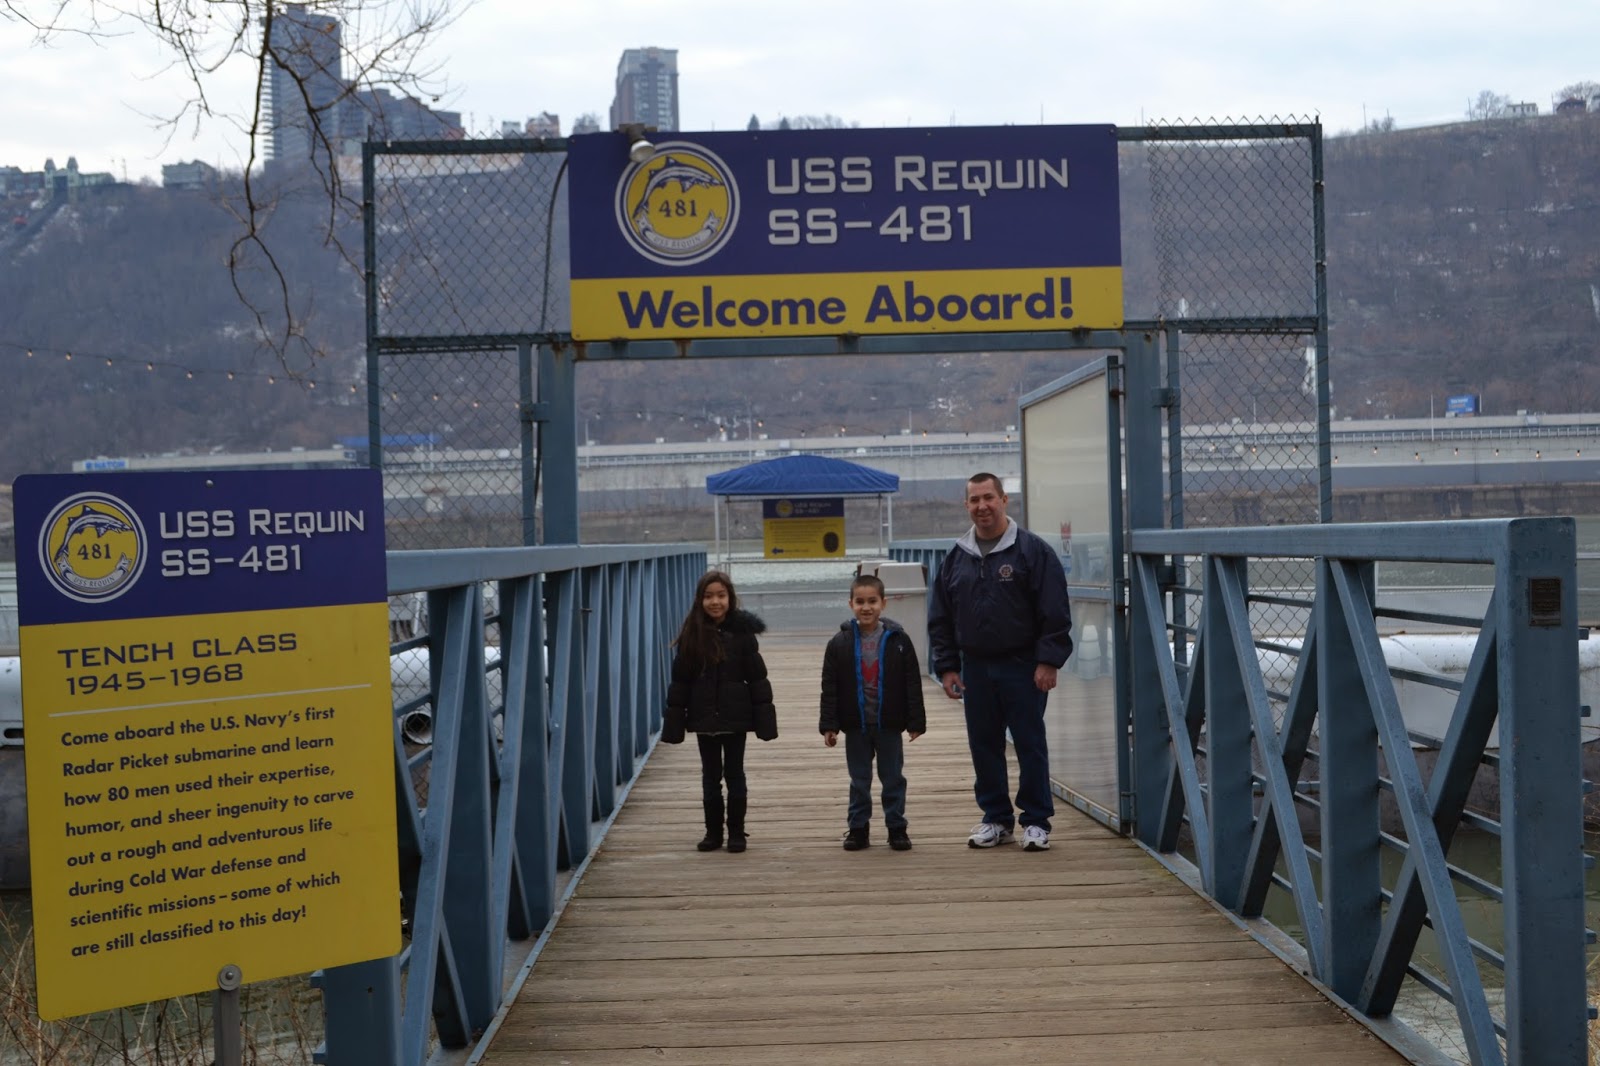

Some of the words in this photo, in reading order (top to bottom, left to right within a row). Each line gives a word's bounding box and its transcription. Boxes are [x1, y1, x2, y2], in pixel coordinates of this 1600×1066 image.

[767, 157, 872, 194] USS
[895, 156, 1068, 196] REQUIN
[659, 199, 697, 218] 481
[768, 205, 971, 245] SS-481
[618, 285, 846, 329] Welcome
[865, 277, 1073, 323] Aboard!
[159, 510, 234, 538] USS
[249, 509, 364, 538] REQUIN
[77, 543, 112, 560] 481
[161, 544, 301, 577] SS-481
[74, 577, 88, 587] USS
[89, 577, 115, 588] REQUIN
[57, 642, 174, 669] TENCH
[192, 633, 297, 658] CLASS
[66, 662, 243, 695] 1945-1968
[61, 732, 108, 746] Come
[114, 721, 174, 741] aboard
[180, 720, 205, 734] the
[211, 716, 240, 730] U.S.
[245, 710, 300, 728] Navy's
[305, 707, 334, 720] first
[63, 759, 114, 776] Radar
[120, 753, 168, 770] Picket
[175, 744, 256, 764] submarine
[262, 738, 290, 754] and
[296, 736, 333, 750] learn
[64, 792, 102, 806] how
[108, 786, 129, 801] 80
[135, 785, 169, 798] men
[176, 775, 212, 793] used
[218, 771, 254, 787] their
[259, 764, 334, 784] expertise,
[66, 821, 124, 836] humor,
[130, 810, 162, 828] and
[168, 808, 211, 823] sheer
[217, 796, 288, 818] ingenuity
[294, 795, 308, 806] to
[314, 791, 354, 804] carve
[67, 852, 95, 866] out
[100, 852, 111, 862] a
[118, 840, 166, 860] rough
[172, 834, 202, 852] and
[208, 824, 305, 847] adventurous
[310, 817, 332, 832] life
[69, 878, 124, 896] during
[130, 868, 166, 887] Cold
[171, 866, 206, 880] War
[211, 858, 272, 875] defense
[278, 848, 306, 865] and
[70, 904, 142, 927] scientific
[276, 878, 292, 893] of
[296, 871, 340, 890] which
[72, 944, 100, 956] are
[106, 932, 134, 951] still
[140, 919, 213, 944] classified
[218, 920, 234, 931] to
[240, 912, 266, 928] this
[272, 905, 306, 922] day!
